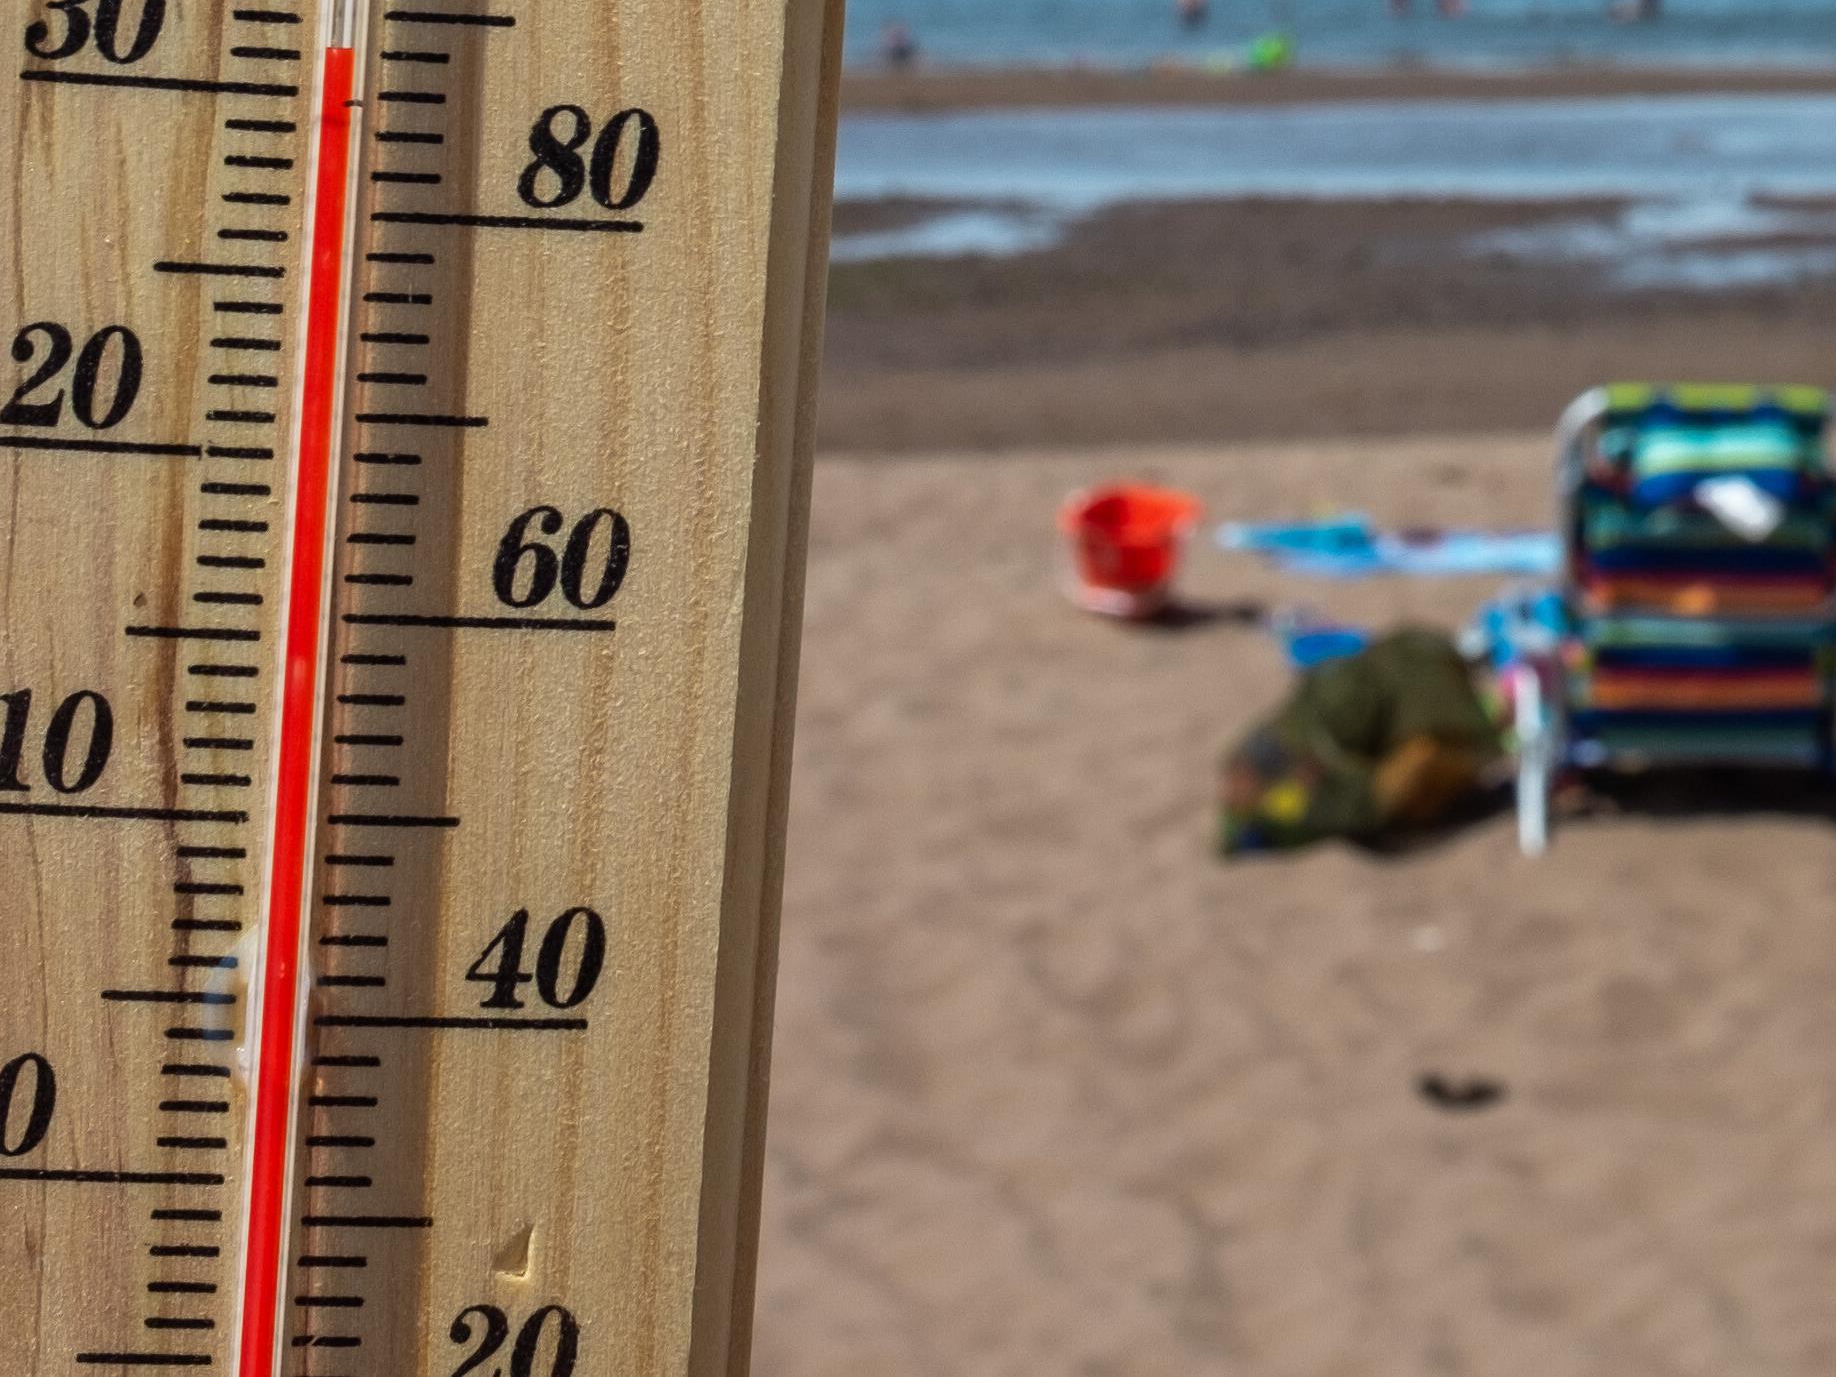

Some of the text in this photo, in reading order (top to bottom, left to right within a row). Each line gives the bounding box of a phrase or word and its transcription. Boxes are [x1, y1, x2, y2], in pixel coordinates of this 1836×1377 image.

[517, 104, 660, 210] 80
[0, 322, 143, 430] 20
[493, 506, 631, 610] 60
[0, 688, 114, 794] 10
[465, 907, 606, 1010] 40
[449, 1304, 580, 1377] 20
